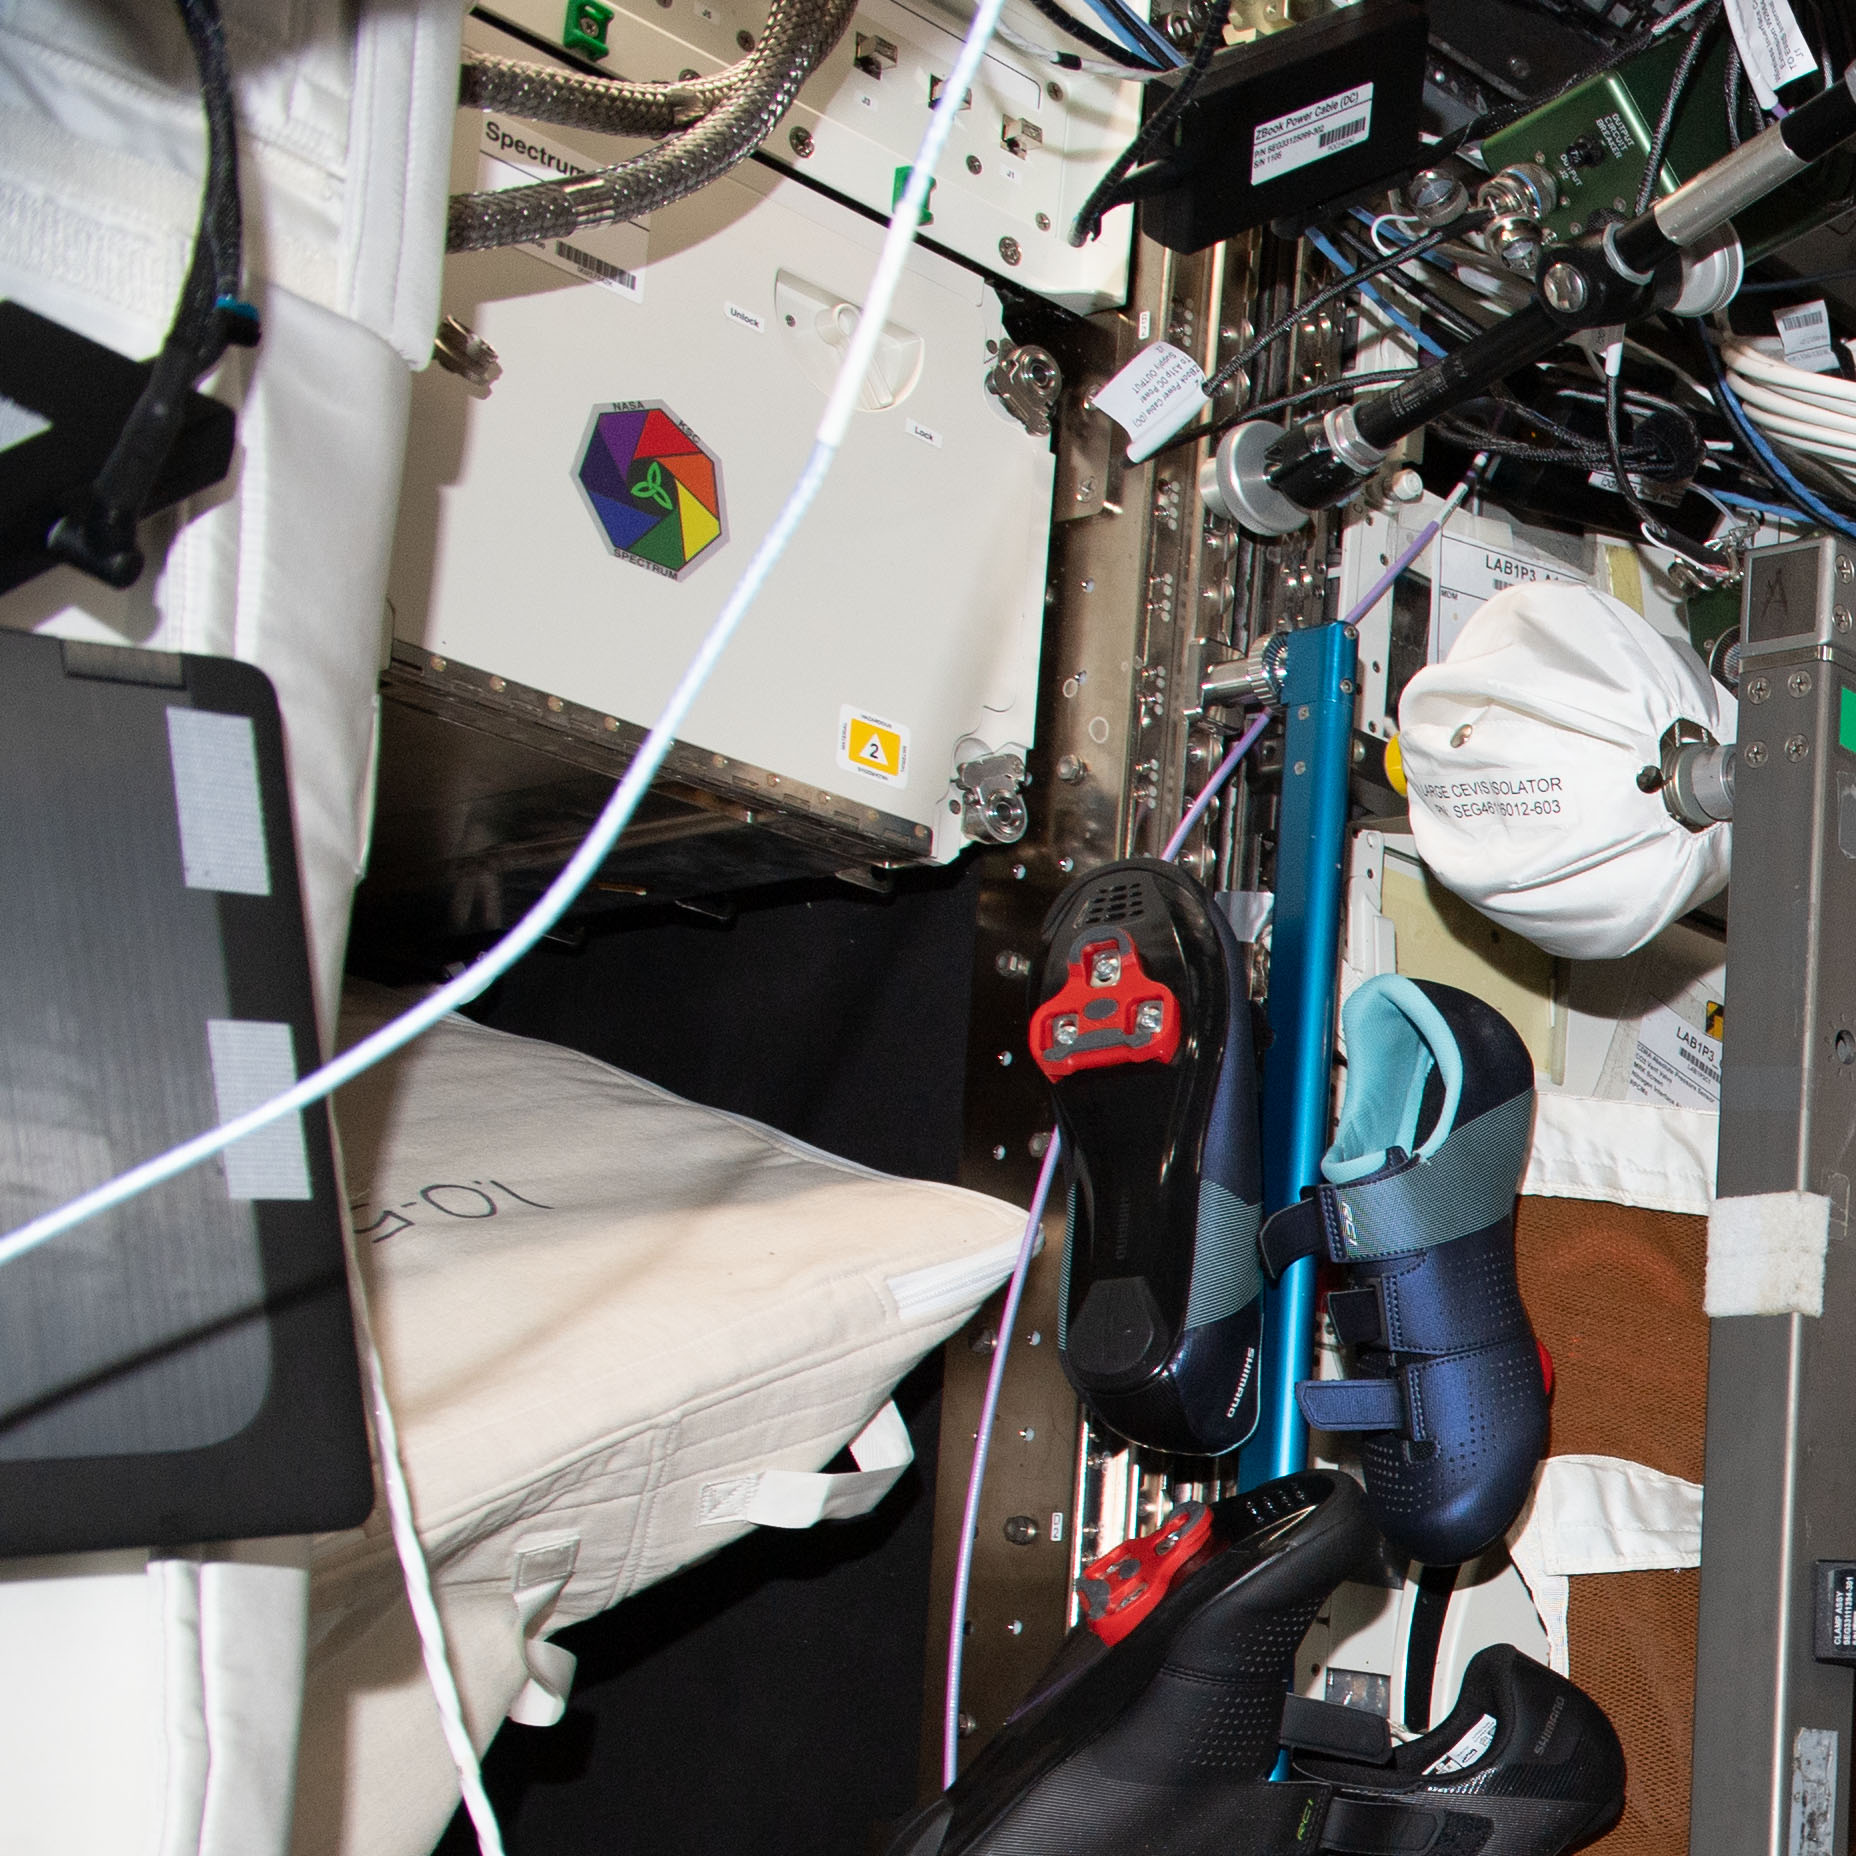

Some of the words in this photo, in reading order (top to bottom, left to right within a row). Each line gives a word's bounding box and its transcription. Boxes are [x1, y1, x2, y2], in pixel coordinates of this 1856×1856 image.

[1286, 111, 1313, 129] Power
[1314, 101, 1339, 118] Cable
[729, 306, 760, 329] Unlock
[612, 400, 646, 413] NASA
[677, 417, 702, 445] KSC
[914, 425, 934, 442] Lock
[613, 547, 679, 581] SPECTRUM
[869, 742, 879, 759] 2
[1226, 1346, 1255, 1418] SHIMANO
[1834, 1615, 1842, 1646] CLAMP
[1533, 1695, 1563, 1757] SHIMANO
